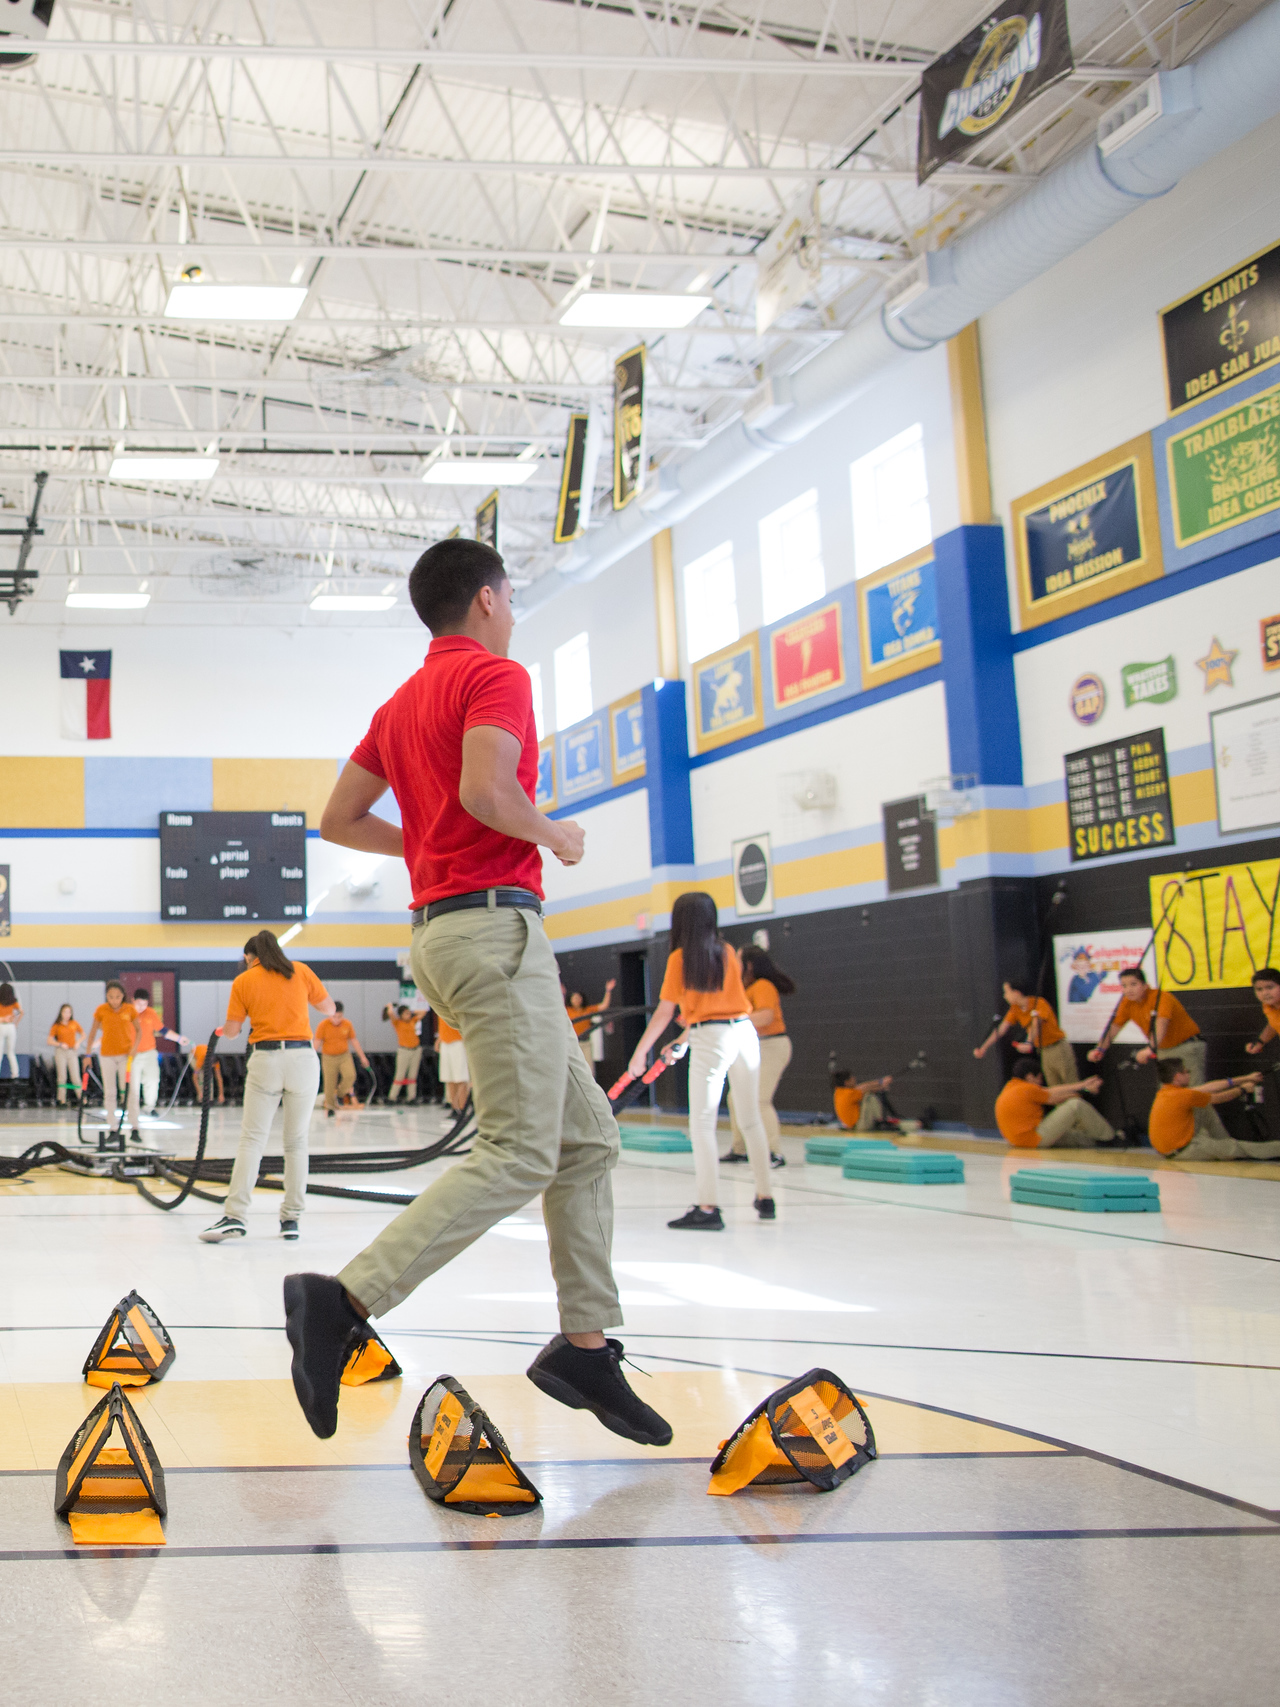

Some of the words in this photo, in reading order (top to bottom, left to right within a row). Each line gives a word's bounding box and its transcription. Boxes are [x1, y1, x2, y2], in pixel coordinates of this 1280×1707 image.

[937, 11, 1042, 141] CHAMPIONS
[1202, 263, 1260, 314] SAINTS
[1185, 368, 1220, 400] IDEA
[1221, 351, 1252, 382] SAN
[1049, 481, 1107, 524] PHOENIX
[1208, 497, 1241, 525] IDEA
[1045, 569, 1072, 593] IDEA
[1074, 547, 1123, 582] MISSION
[1132, 675, 1169, 701] TAKES
[1115, 747, 1128, 761] BE
[1116, 761, 1129, 776] BE
[1117, 775, 1130, 790] BE
[1120, 789, 1132, 803] BE
[166, 813, 193, 826] Home
[1075, 812, 1166, 857] SUCCESS
[220, 849, 249, 863] period
[220, 866, 250, 880] player
[168, 905, 187, 916] won
[223, 905, 247, 918] game
[284, 905, 303, 916] won
[1161, 866, 1280, 984] STAY
